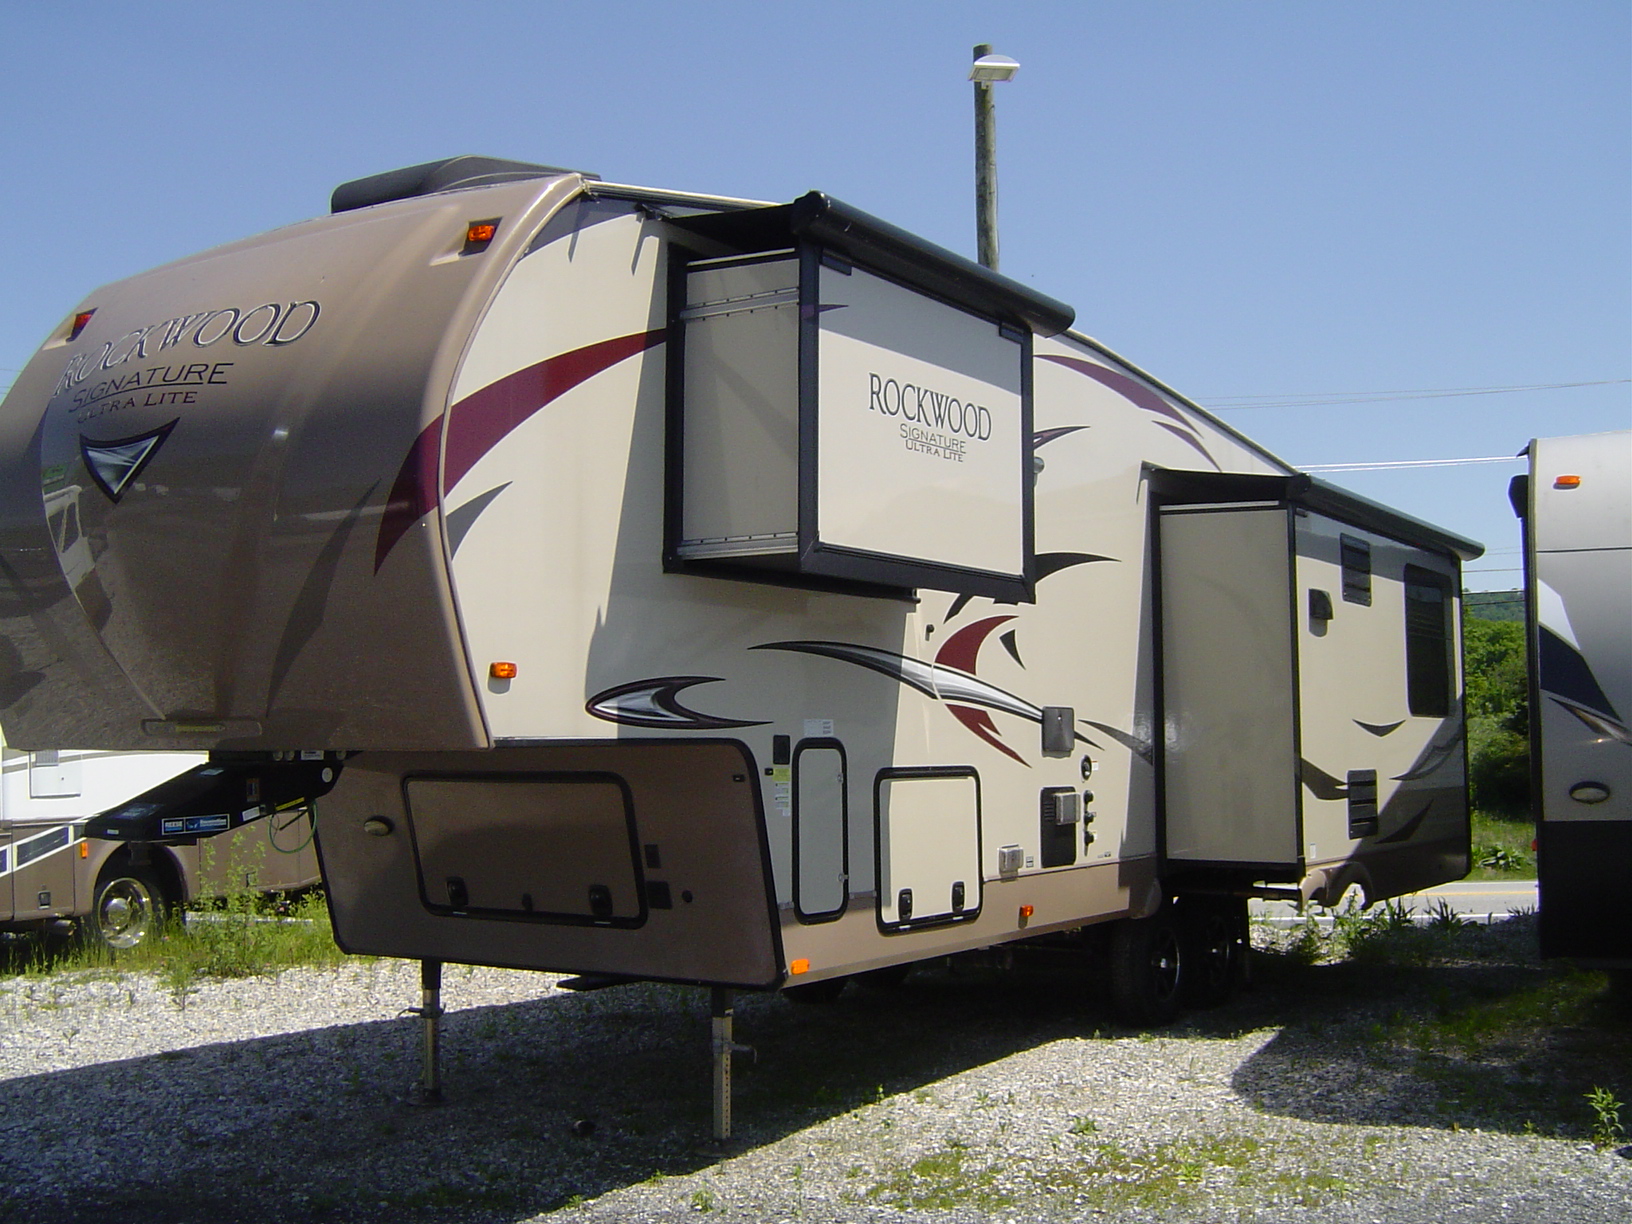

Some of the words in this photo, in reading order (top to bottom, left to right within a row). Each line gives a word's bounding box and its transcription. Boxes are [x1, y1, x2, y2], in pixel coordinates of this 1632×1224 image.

[53, 300, 321, 398] ROCKWOOD
[69, 362, 234, 413] SIGNATURE
[77, 398, 136, 424] ULTRA
[143, 391, 198, 407] LITE
[869, 372, 992, 442] ROCKWOOD
[899, 423, 967, 454] SIGNATURE
[905, 439, 941, 457] ULTRA
[943, 448, 964, 463] LITE
